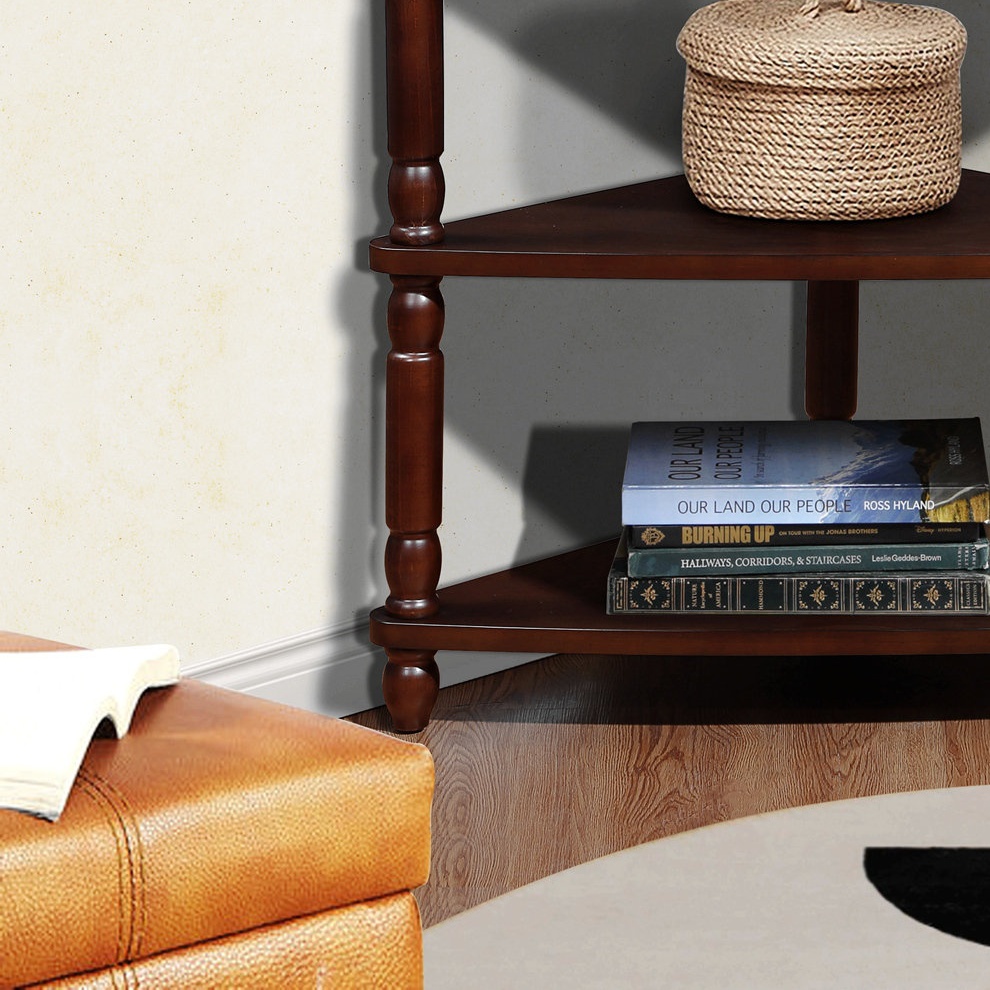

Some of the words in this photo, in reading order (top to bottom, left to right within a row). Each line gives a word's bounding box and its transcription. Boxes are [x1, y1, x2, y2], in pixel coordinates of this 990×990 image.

[671, 426, 705, 456] LAND
[716, 426, 744, 460] PEOPLE
[668, 457, 702, 481] OUR
[714, 461, 742, 480] OUR
[677, 500, 708, 514] OUR
[714, 500, 755, 514] LAND
[760, 499, 791, 513] OUR
[797, 499, 852, 513] PEOPLE
[863, 500, 890, 511] ROSS
[893, 500, 935, 511] HYLAND
[681, 525, 751, 545] BURNING
[754, 525, 775, 544] UP
[681, 557, 734, 569] HALLWAYS,
[735, 556, 796, 567] CORRIDORS,
[796, 557, 805, 566] &
[806, 555, 862, 566] STAIRCASES
[872, 554, 892, 563] Leslie
[892, 553, 942, 563] Geddes-Brown
